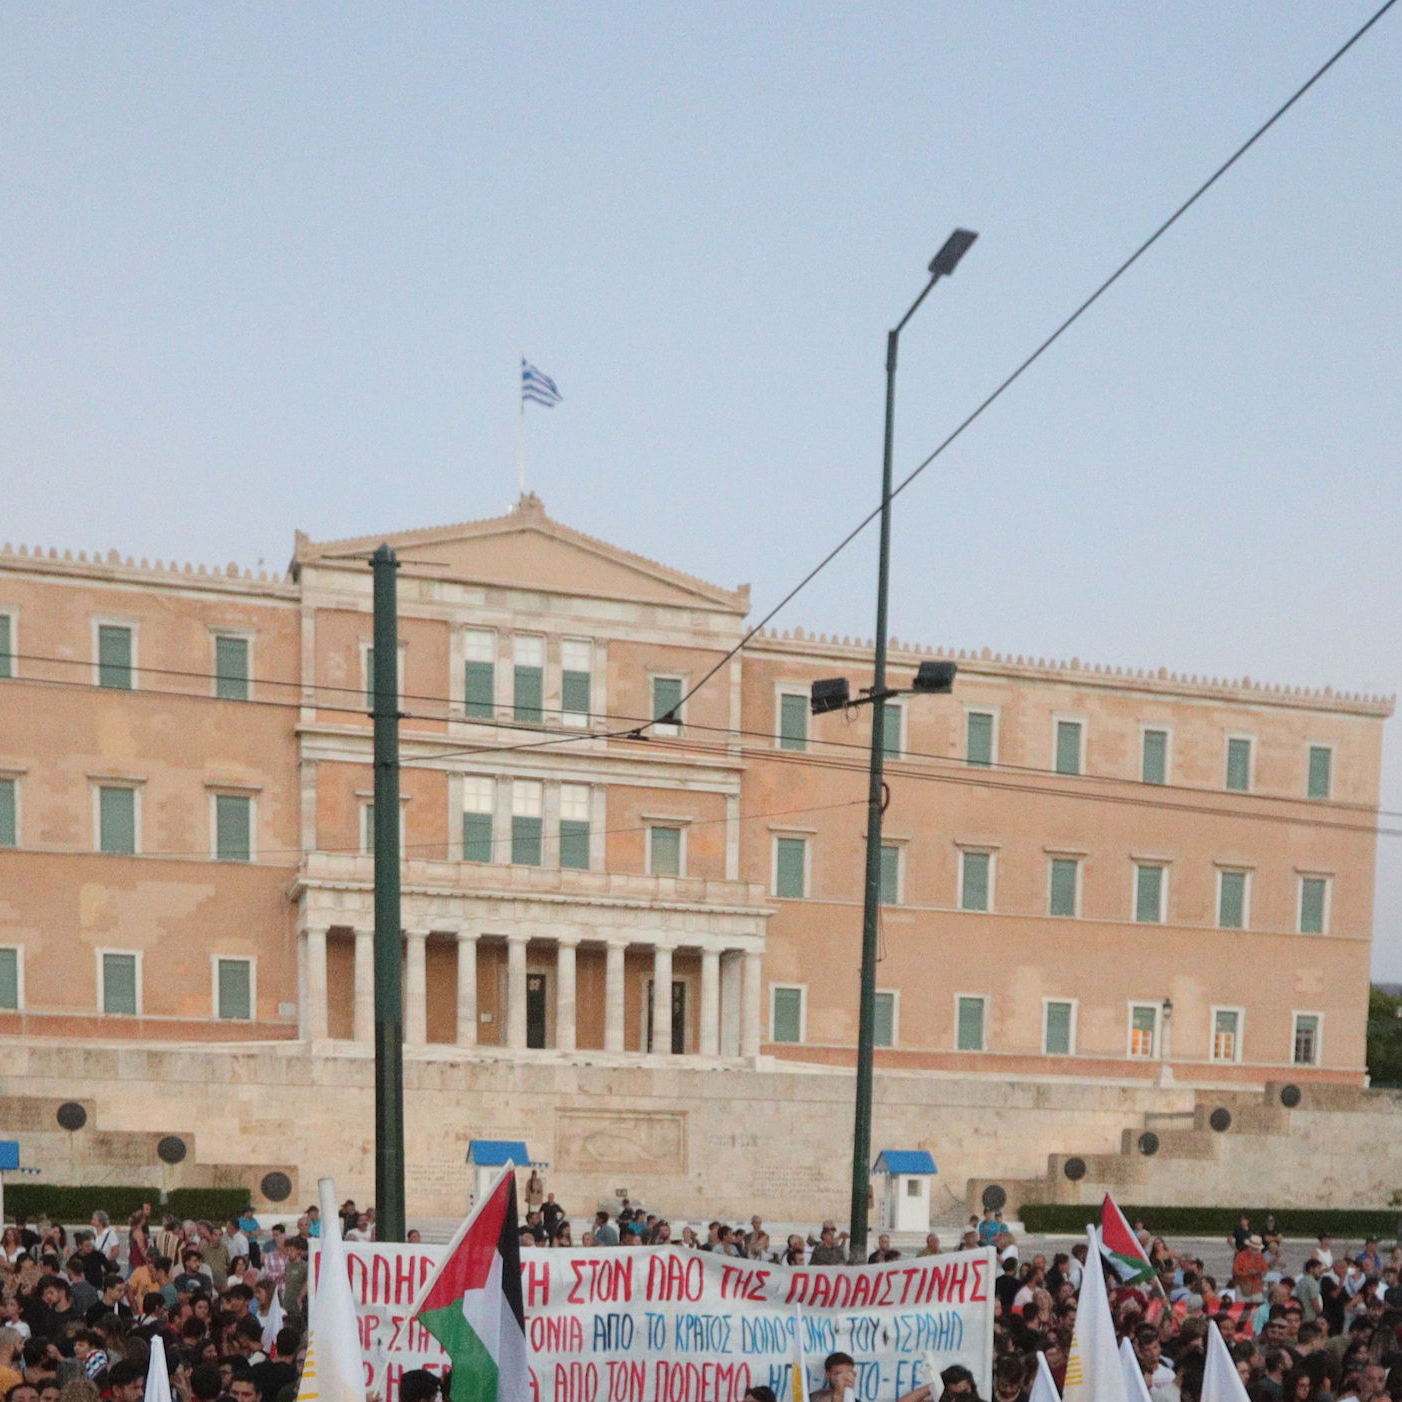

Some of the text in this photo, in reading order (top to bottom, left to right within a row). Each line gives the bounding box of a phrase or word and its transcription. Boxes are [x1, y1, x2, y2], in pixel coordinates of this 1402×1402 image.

[567, 1255, 633, 1304] ΣΤΟΝ
[646, 1254, 704, 1301] ΛΑΟ
[720, 1263, 771, 1301] ΤΗΣ
[785, 1259, 990, 1307] ΠΑΛΑΙΣΤΙΝΗΣ
[593, 1313, 634, 1352] ΑΠΟ
[645, 1312, 666, 1351] ΤΟ
[675, 1314, 732, 1353] ΚΡΑΤΟΣ
[846, 1316, 881, 1352] ΤΟΥ
[894, 1311, 964, 1352] ΙΣΡΑΗΛ
[605, 1360, 646, 1402] ΤΟΝ
